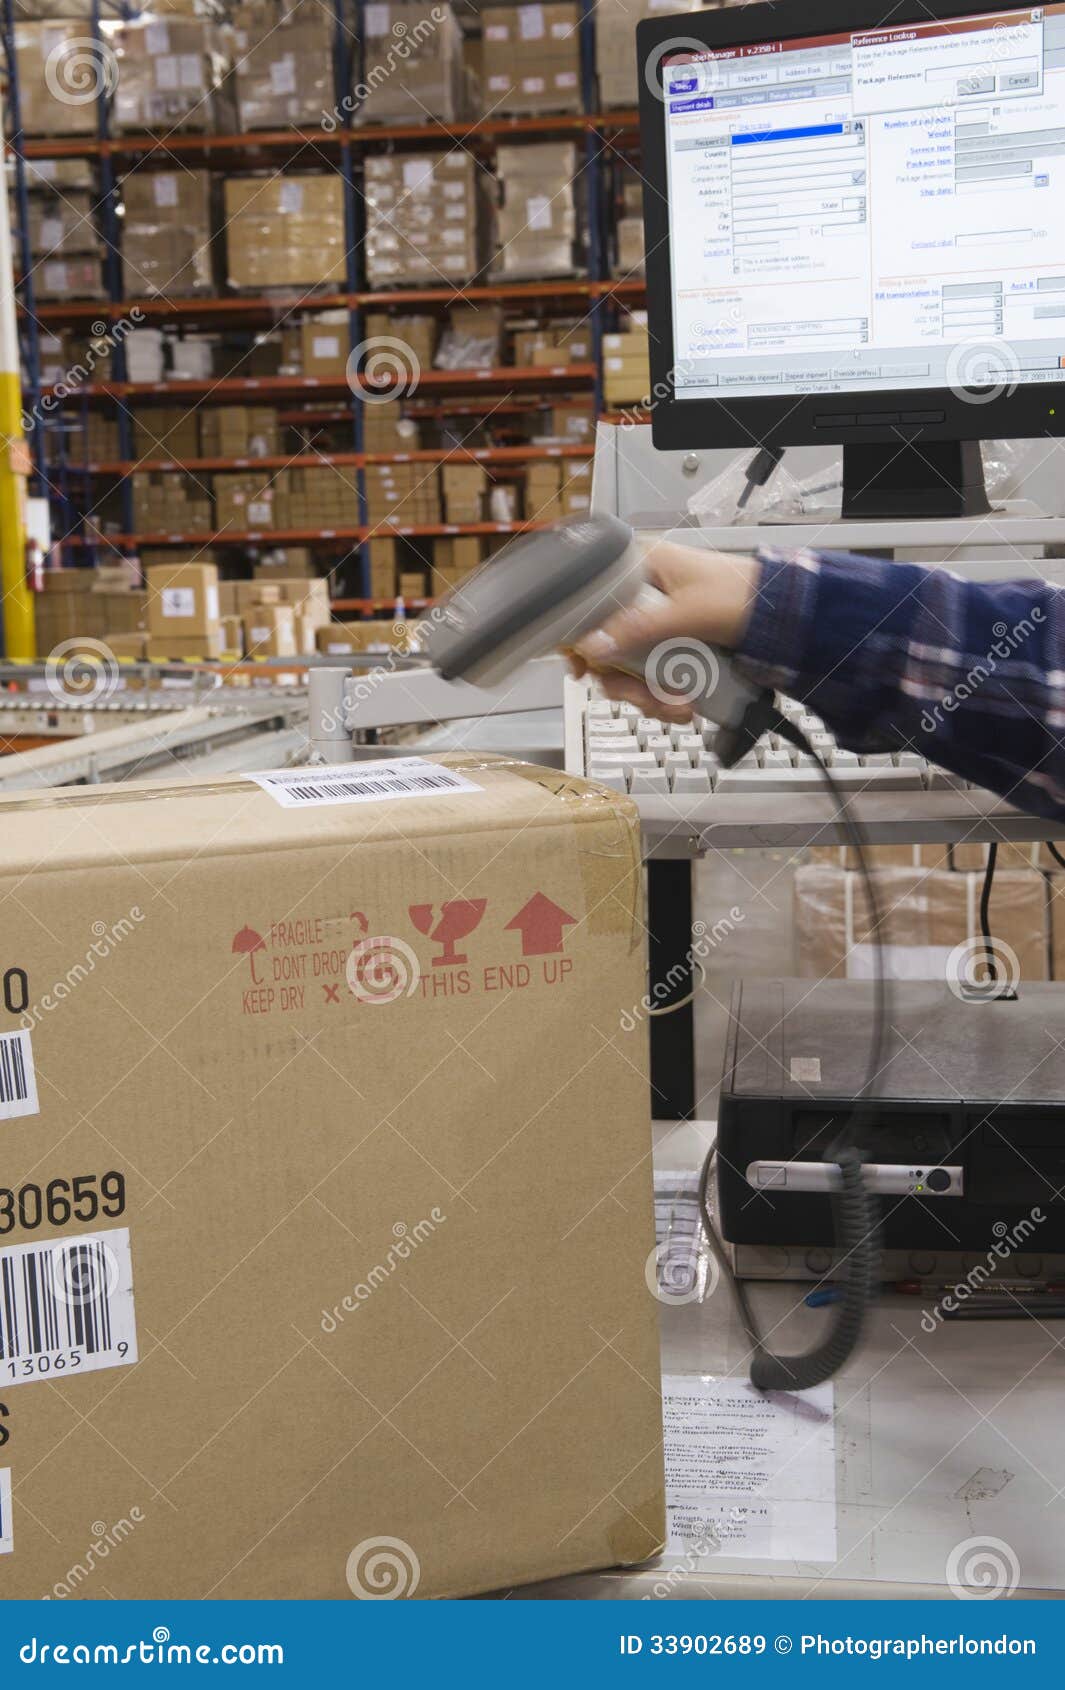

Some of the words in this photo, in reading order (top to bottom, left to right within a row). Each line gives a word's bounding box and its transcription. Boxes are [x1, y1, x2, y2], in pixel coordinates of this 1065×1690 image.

[271, 918, 323, 948] FRAGILE
[272, 954, 308, 981] DONT
[312, 950, 347, 977] DROP
[419, 970, 471, 999] THIS
[483, 963, 531, 992] END
[543, 959, 574, 985] UP
[241, 987, 276, 1015] KEEP
[279, 984, 306, 1012] DRY
